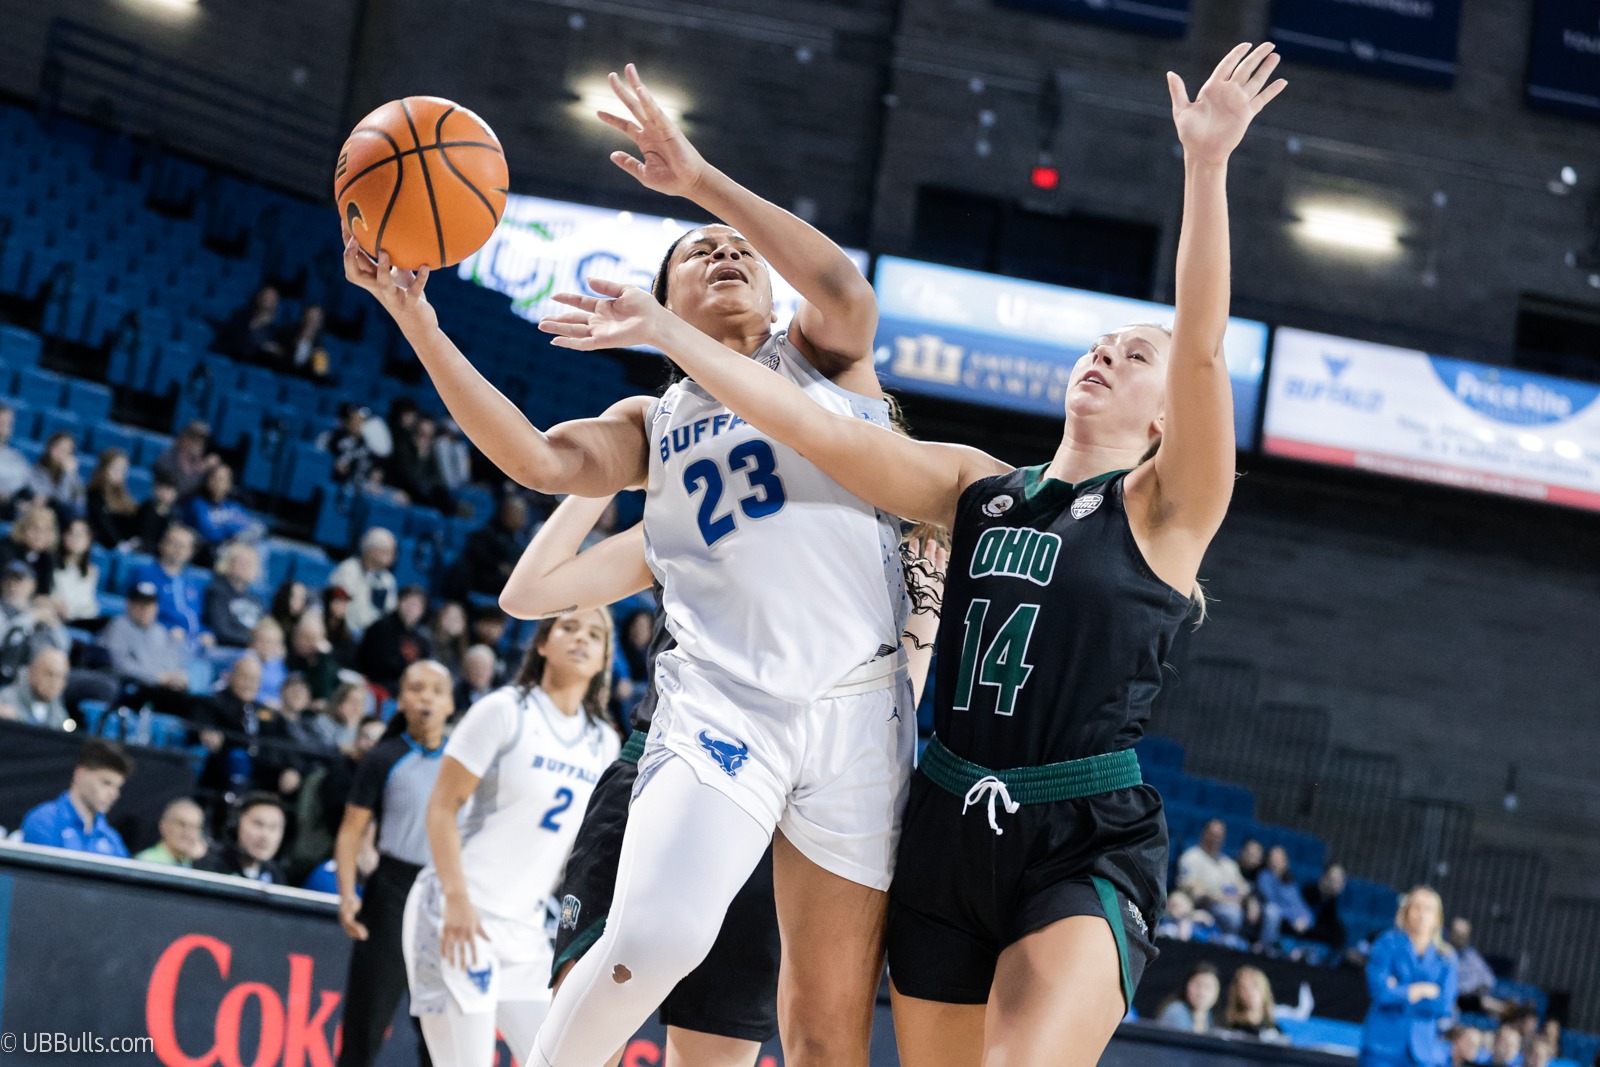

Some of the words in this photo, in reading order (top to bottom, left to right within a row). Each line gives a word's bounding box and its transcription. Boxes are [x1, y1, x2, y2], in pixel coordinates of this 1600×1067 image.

[660, 413, 749, 465] BUFFA
[683, 438, 788, 550] 23
[969, 526, 1062, 586] OHIO
[953, 598, 1041, 716] 14
[538, 786, 574, 832] 2
